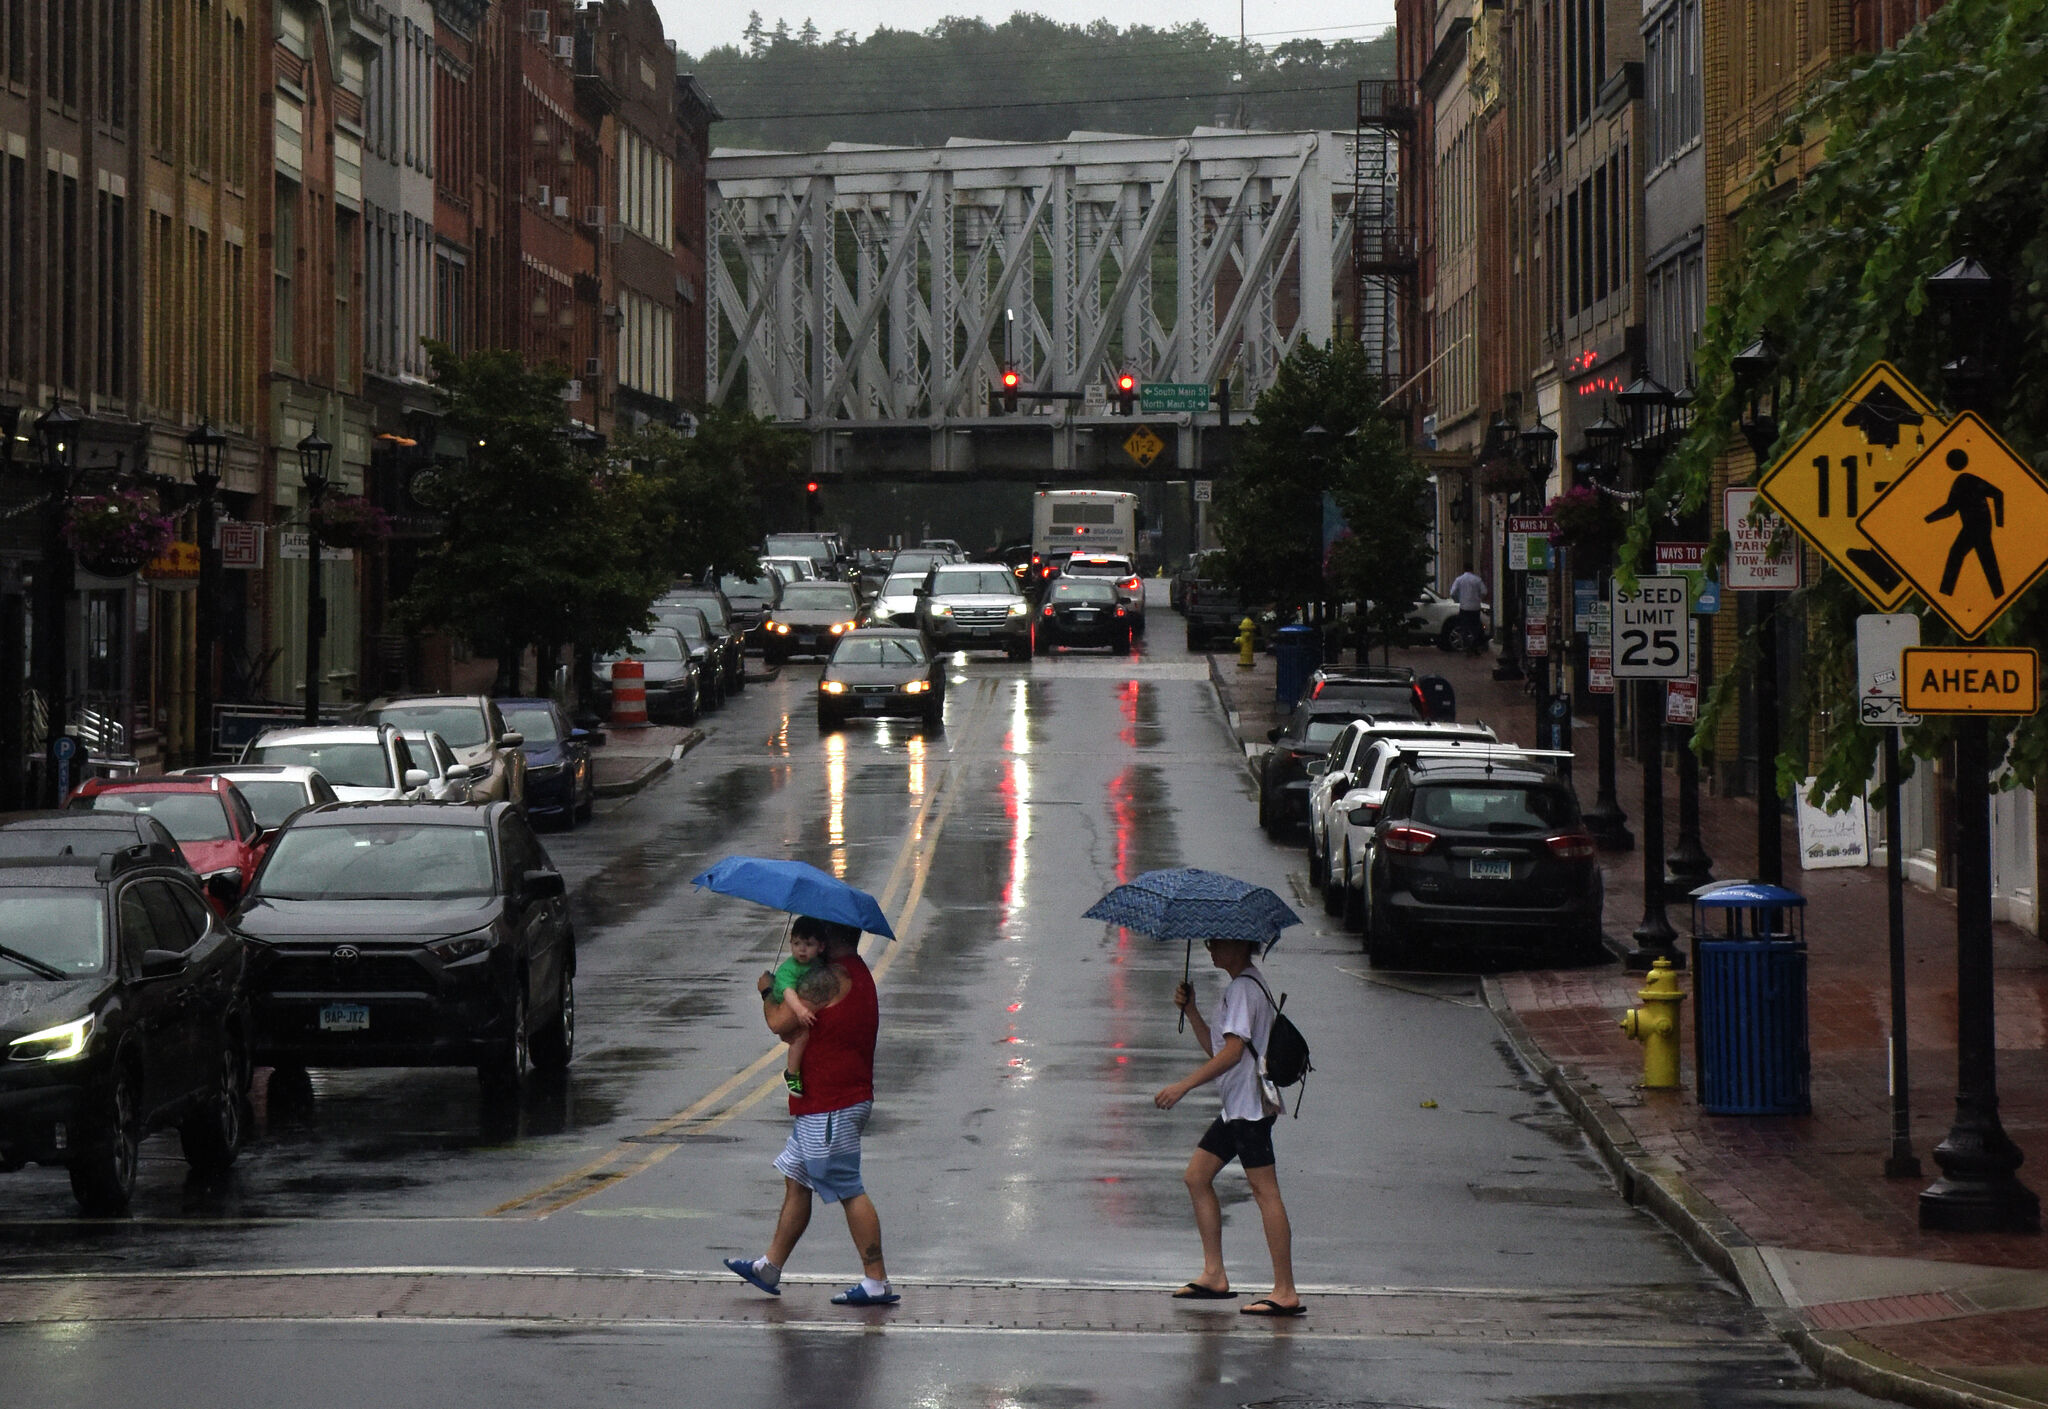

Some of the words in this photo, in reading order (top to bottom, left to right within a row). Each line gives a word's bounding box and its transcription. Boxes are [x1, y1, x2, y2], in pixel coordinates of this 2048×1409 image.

[1153, 387, 1175, 396] South
[1178, 387, 1196, 396] Main
[1198, 387, 1207, 396] St
[1143, 399, 1164, 408] North
[1167, 399, 1185, 408] Main
[1188, 399, 1196, 408] St
[1197, 490, 1210, 499] 25
[1512, 520, 1519, 532] 3
[1519, 521, 1538, 531] WAYS
[1660, 547, 1684, 560] WAYS
[1686, 547, 1697, 560] TO
[1750, 567, 1778, 577] ZONE
[1618, 589, 1682, 604] SPEED
[1625, 609, 1675, 625] LIMIT
[1621, 630, 1680, 667] 25
[1921, 669, 2020, 694] AHEAD
[60, 741, 71, 756] P
